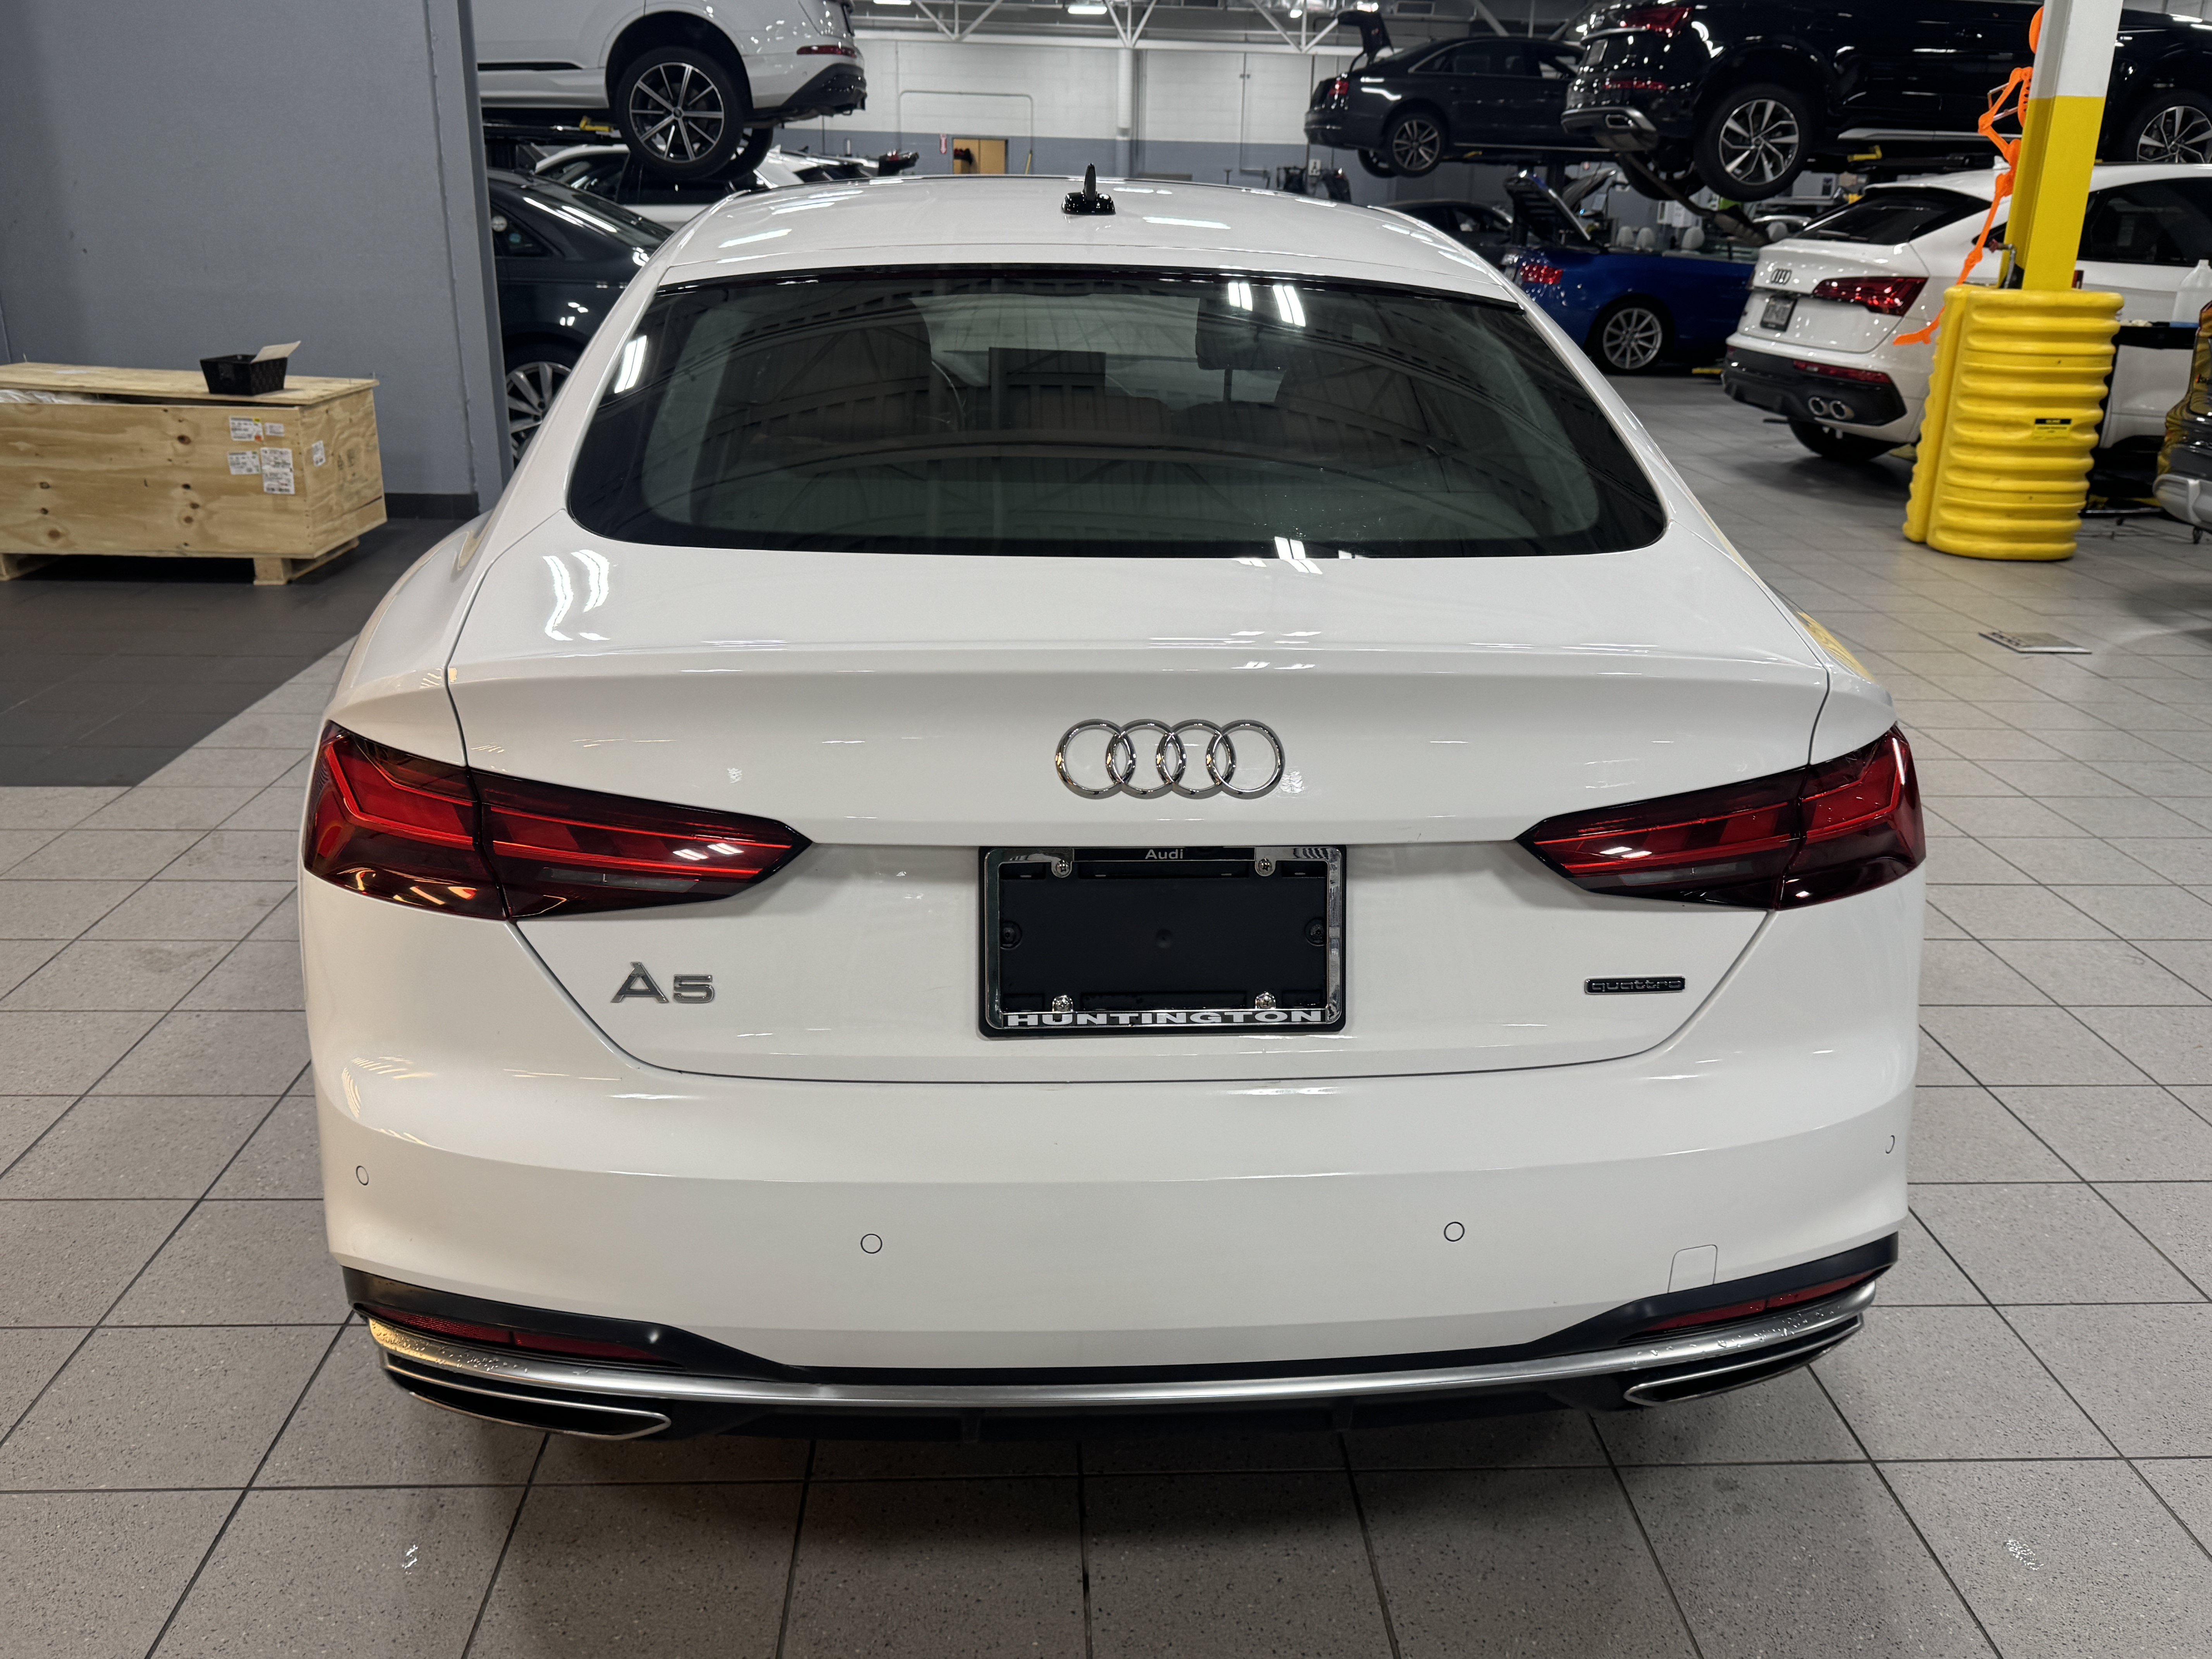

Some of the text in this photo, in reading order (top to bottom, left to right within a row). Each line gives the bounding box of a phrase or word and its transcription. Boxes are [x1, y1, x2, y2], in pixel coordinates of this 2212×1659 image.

[1145, 849, 1183, 859] Audi
[610, 962, 715, 1003] A5
[1592, 980, 1681, 992] quattro
[1008, 1011, 1321, 1026] HUNTINGTON
